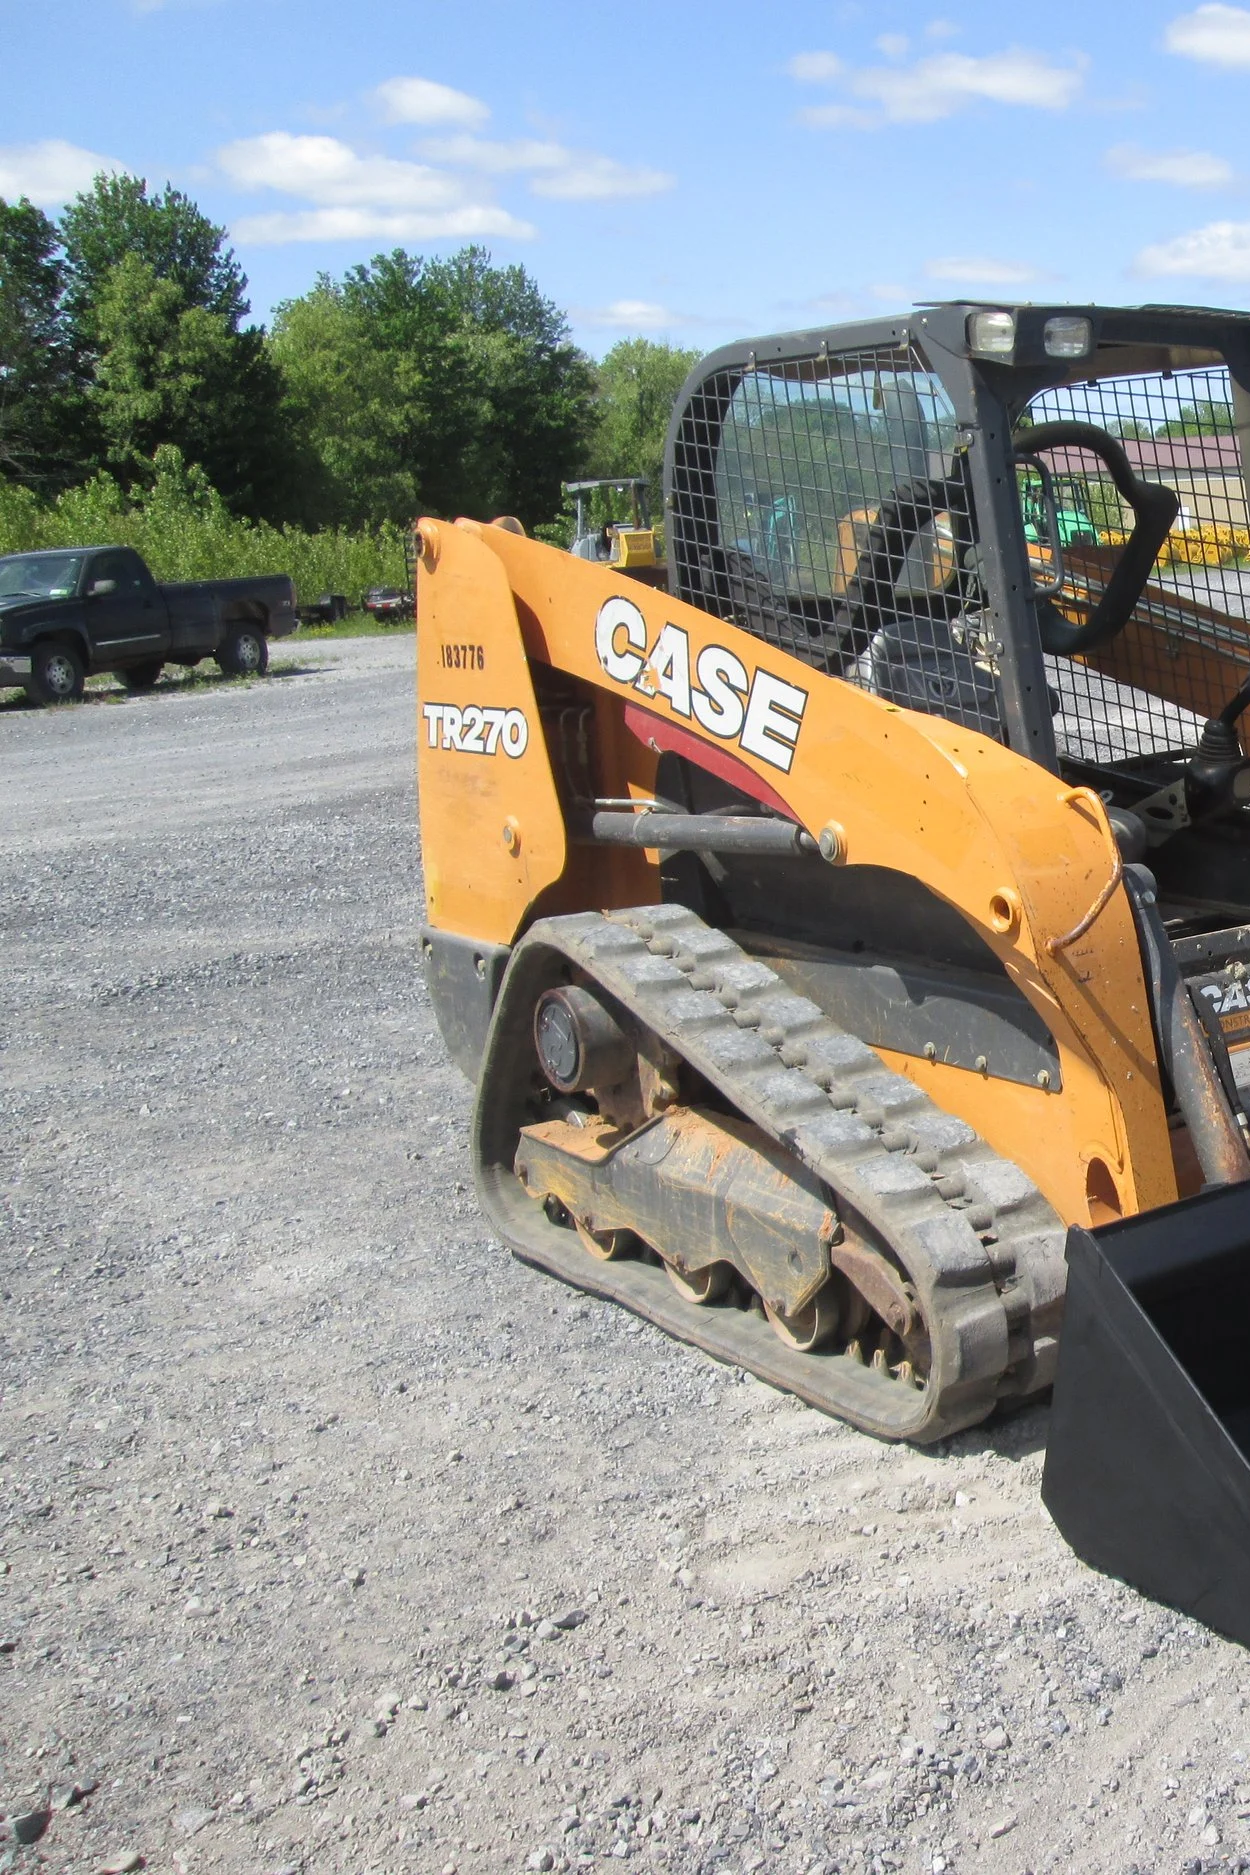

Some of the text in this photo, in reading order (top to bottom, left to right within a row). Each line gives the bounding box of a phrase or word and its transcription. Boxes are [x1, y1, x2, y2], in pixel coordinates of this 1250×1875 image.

[441, 644, 484, 670] 183776
[594, 595, 809, 775] CASE
[423, 702, 529, 760] TR270
